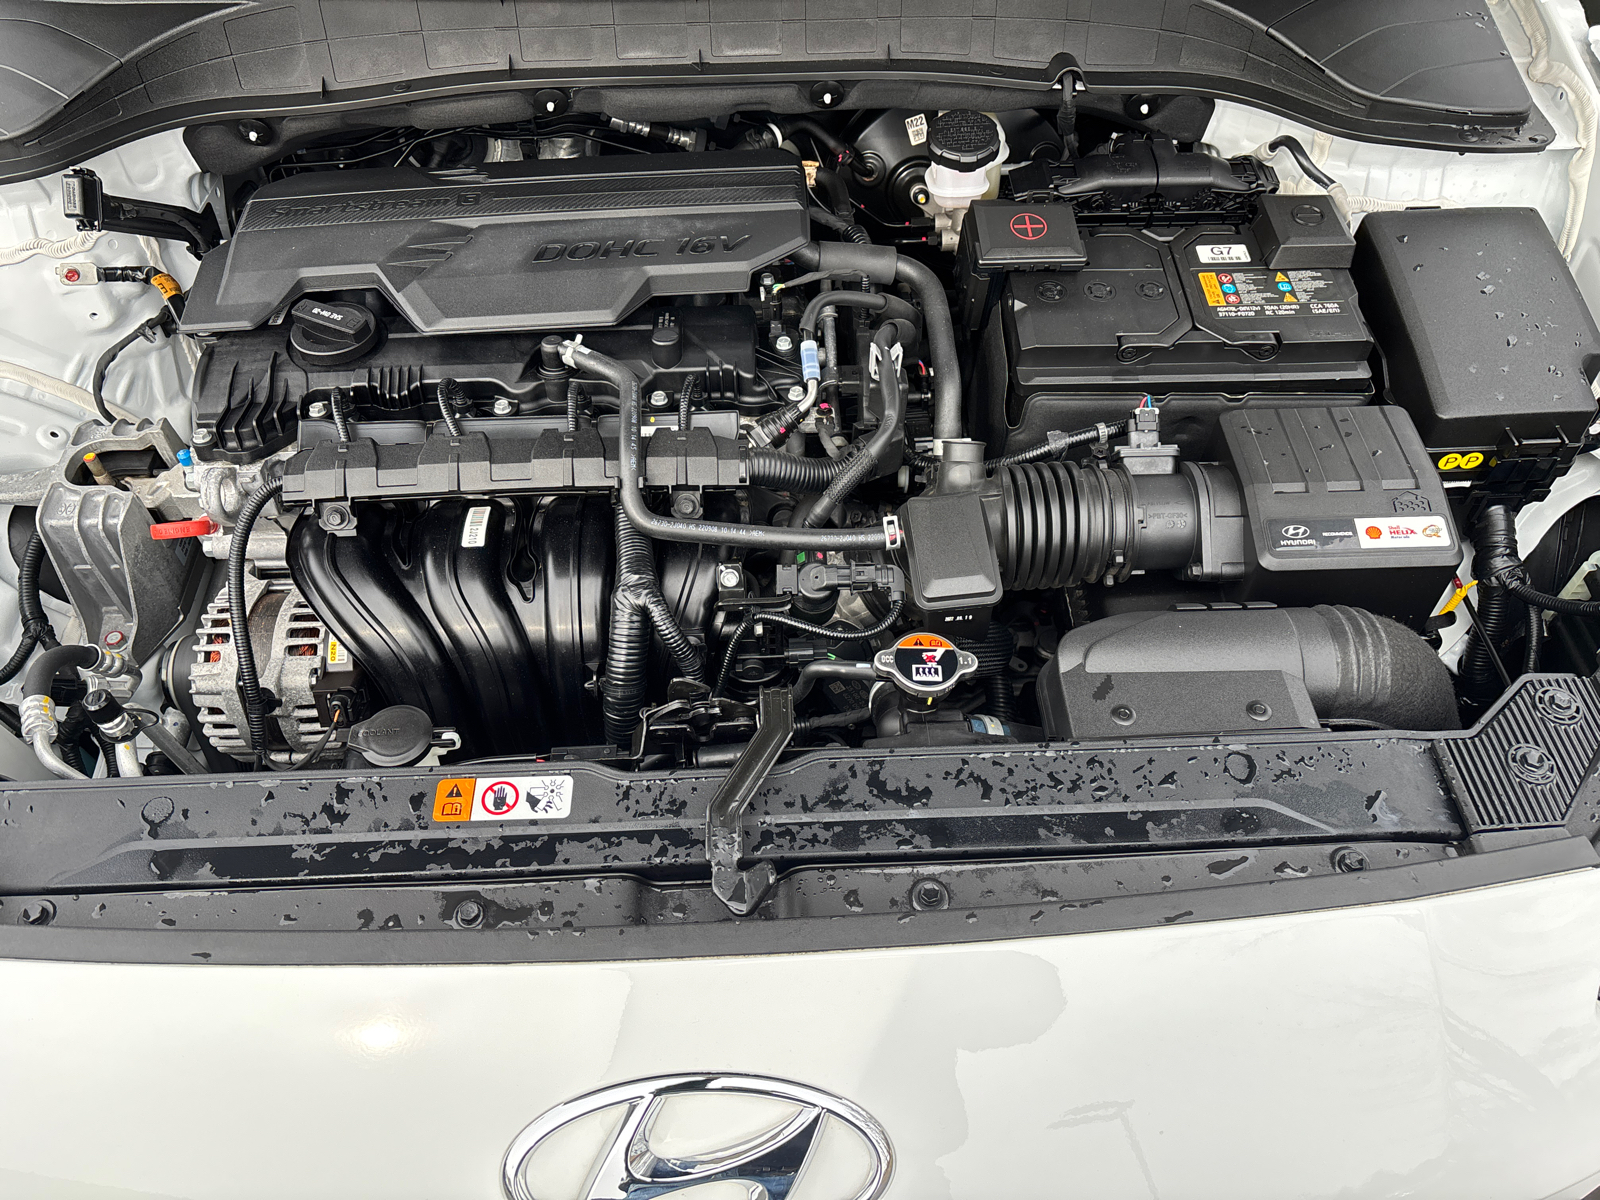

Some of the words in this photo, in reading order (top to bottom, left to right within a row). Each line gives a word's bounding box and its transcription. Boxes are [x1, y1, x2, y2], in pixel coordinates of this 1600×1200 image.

[906, 116, 925, 129] M22
[532, 239, 666, 264] DOHC
[675, 234, 751, 256] 16V
[1210, 246, 1233, 256] G7
[867, 533, 885, 541] 22090
[958, 656, 973, 665] 1.1
